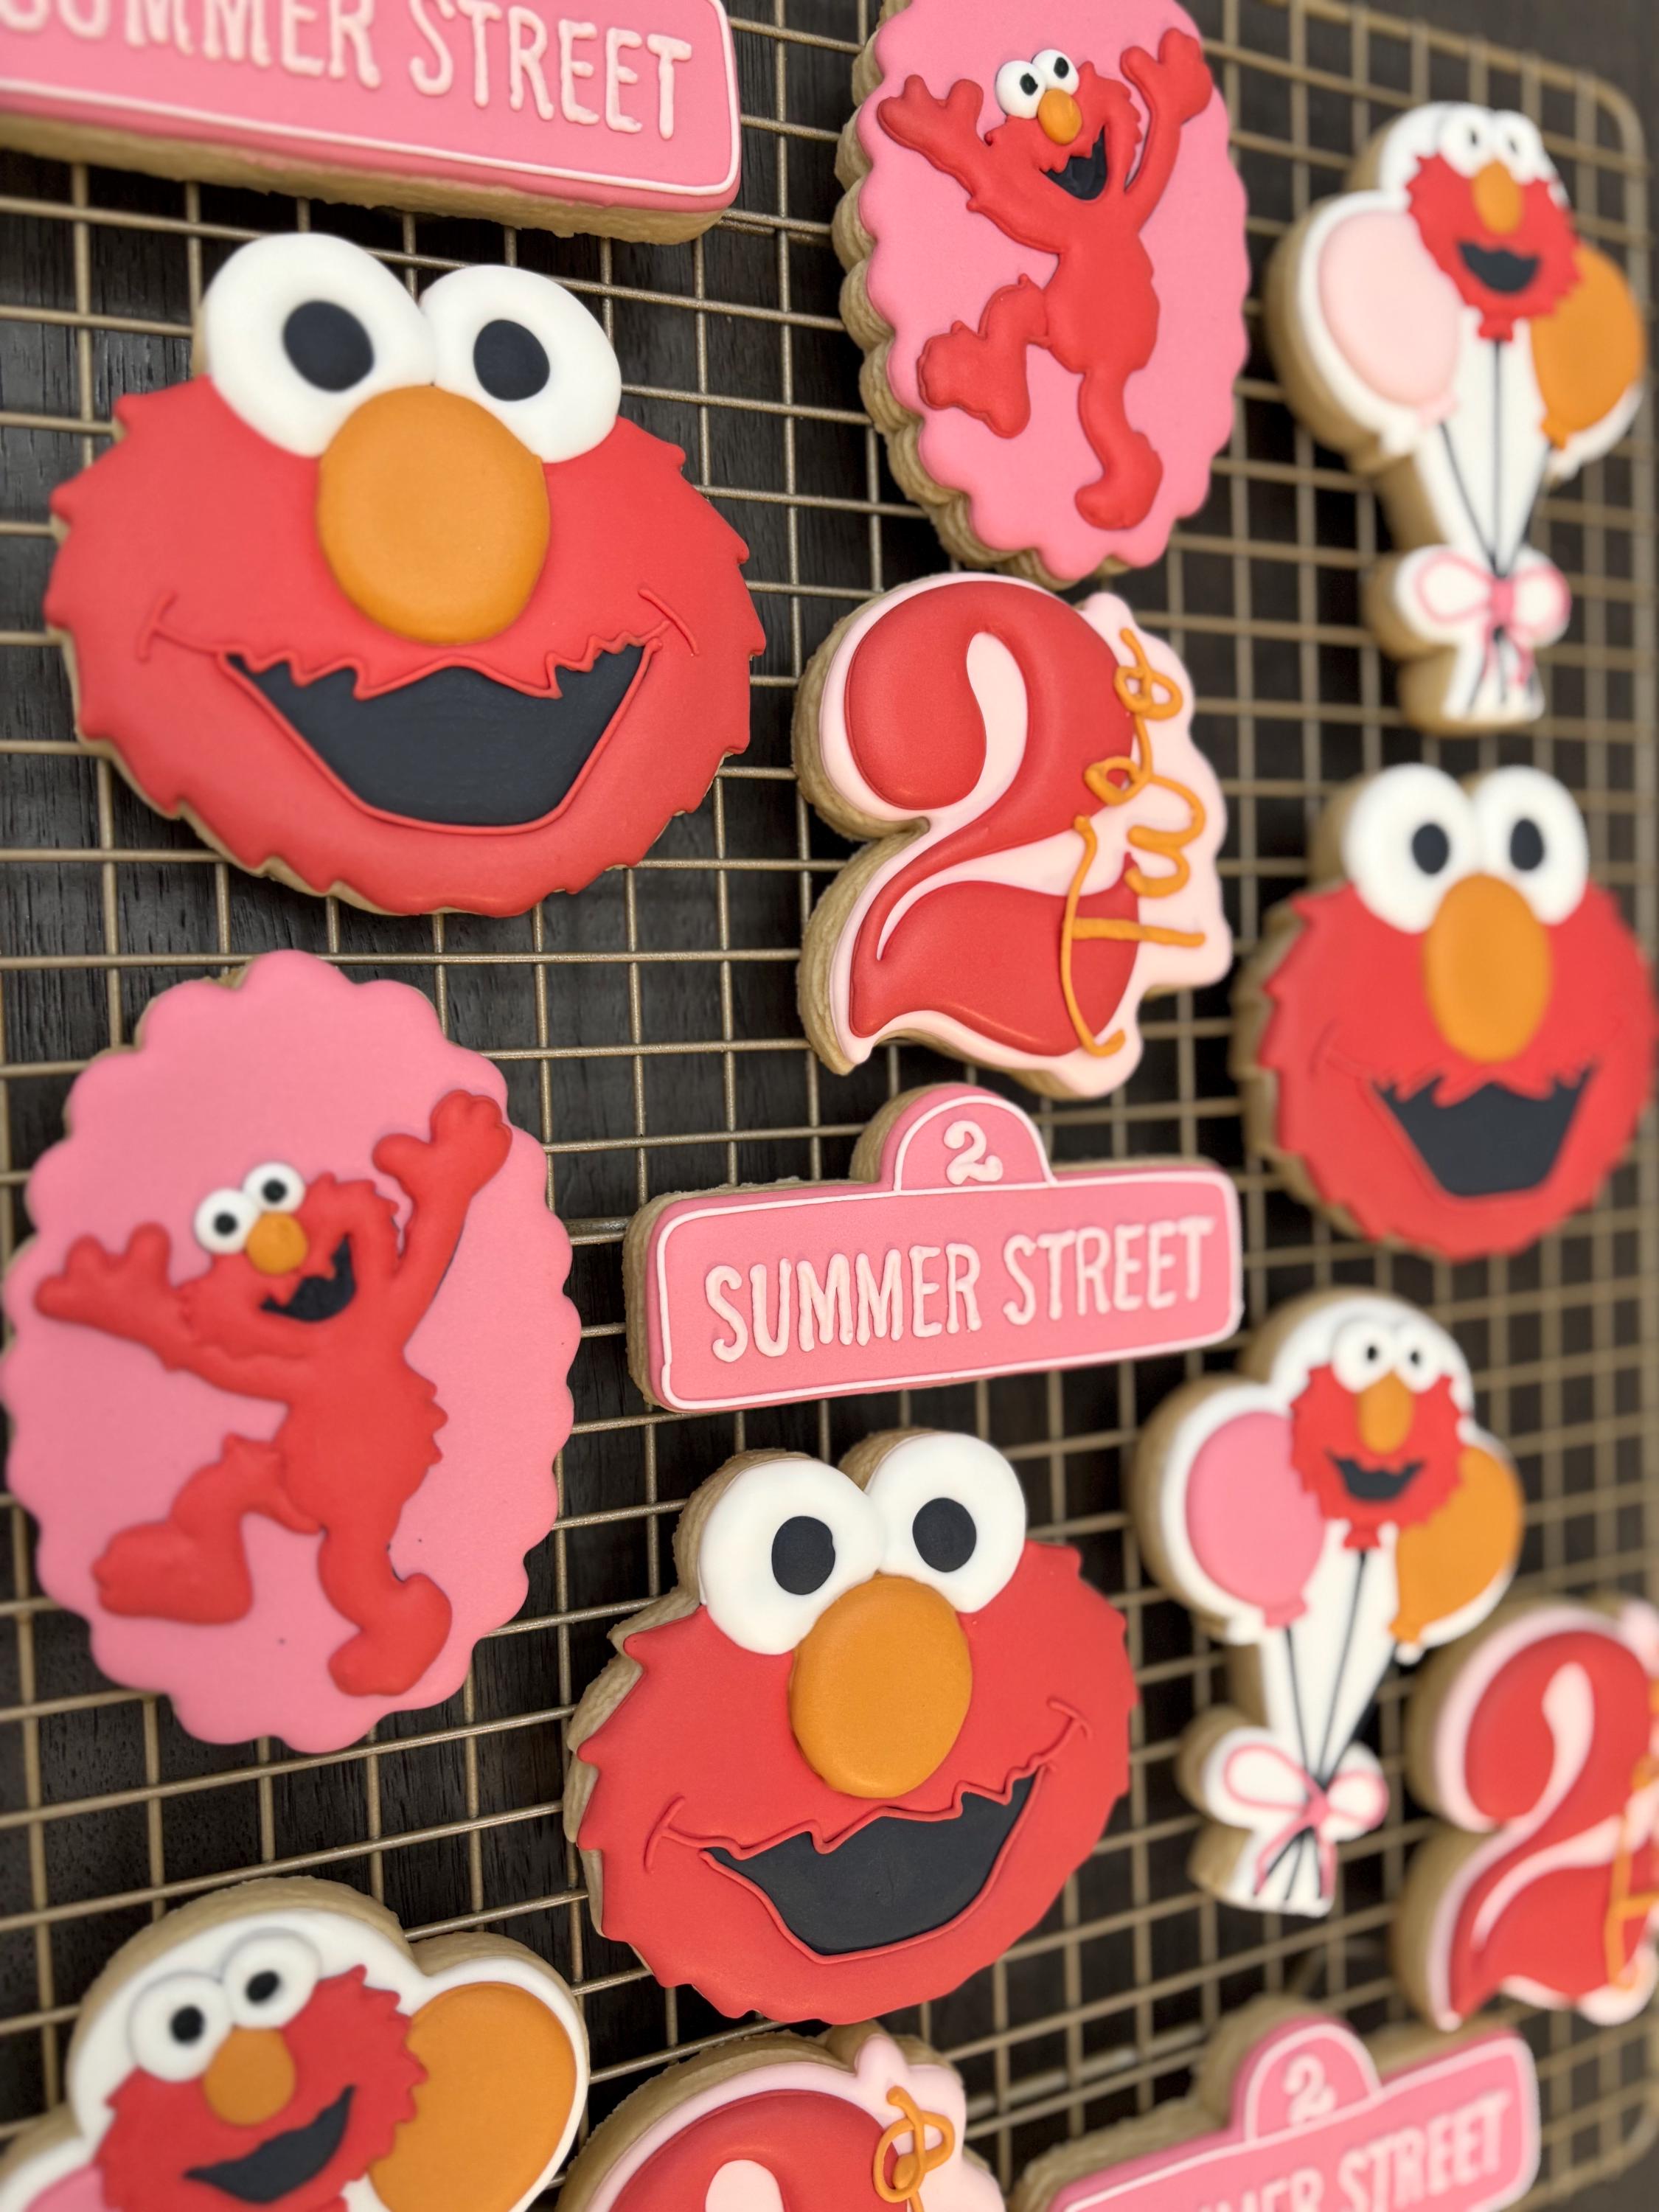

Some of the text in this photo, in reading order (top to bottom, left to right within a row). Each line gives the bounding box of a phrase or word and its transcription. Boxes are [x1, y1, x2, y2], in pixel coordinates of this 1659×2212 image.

[409, 0, 692, 140] STREET
[844, 580, 1140, 1057] 2
[942, 1119, 1004, 1186] 2
[704, 1215, 1214, 1363] SUMMER STREET
[1281, 2054, 1337, 2128] 2
[1337, 2088, 1511, 2212] STREET
